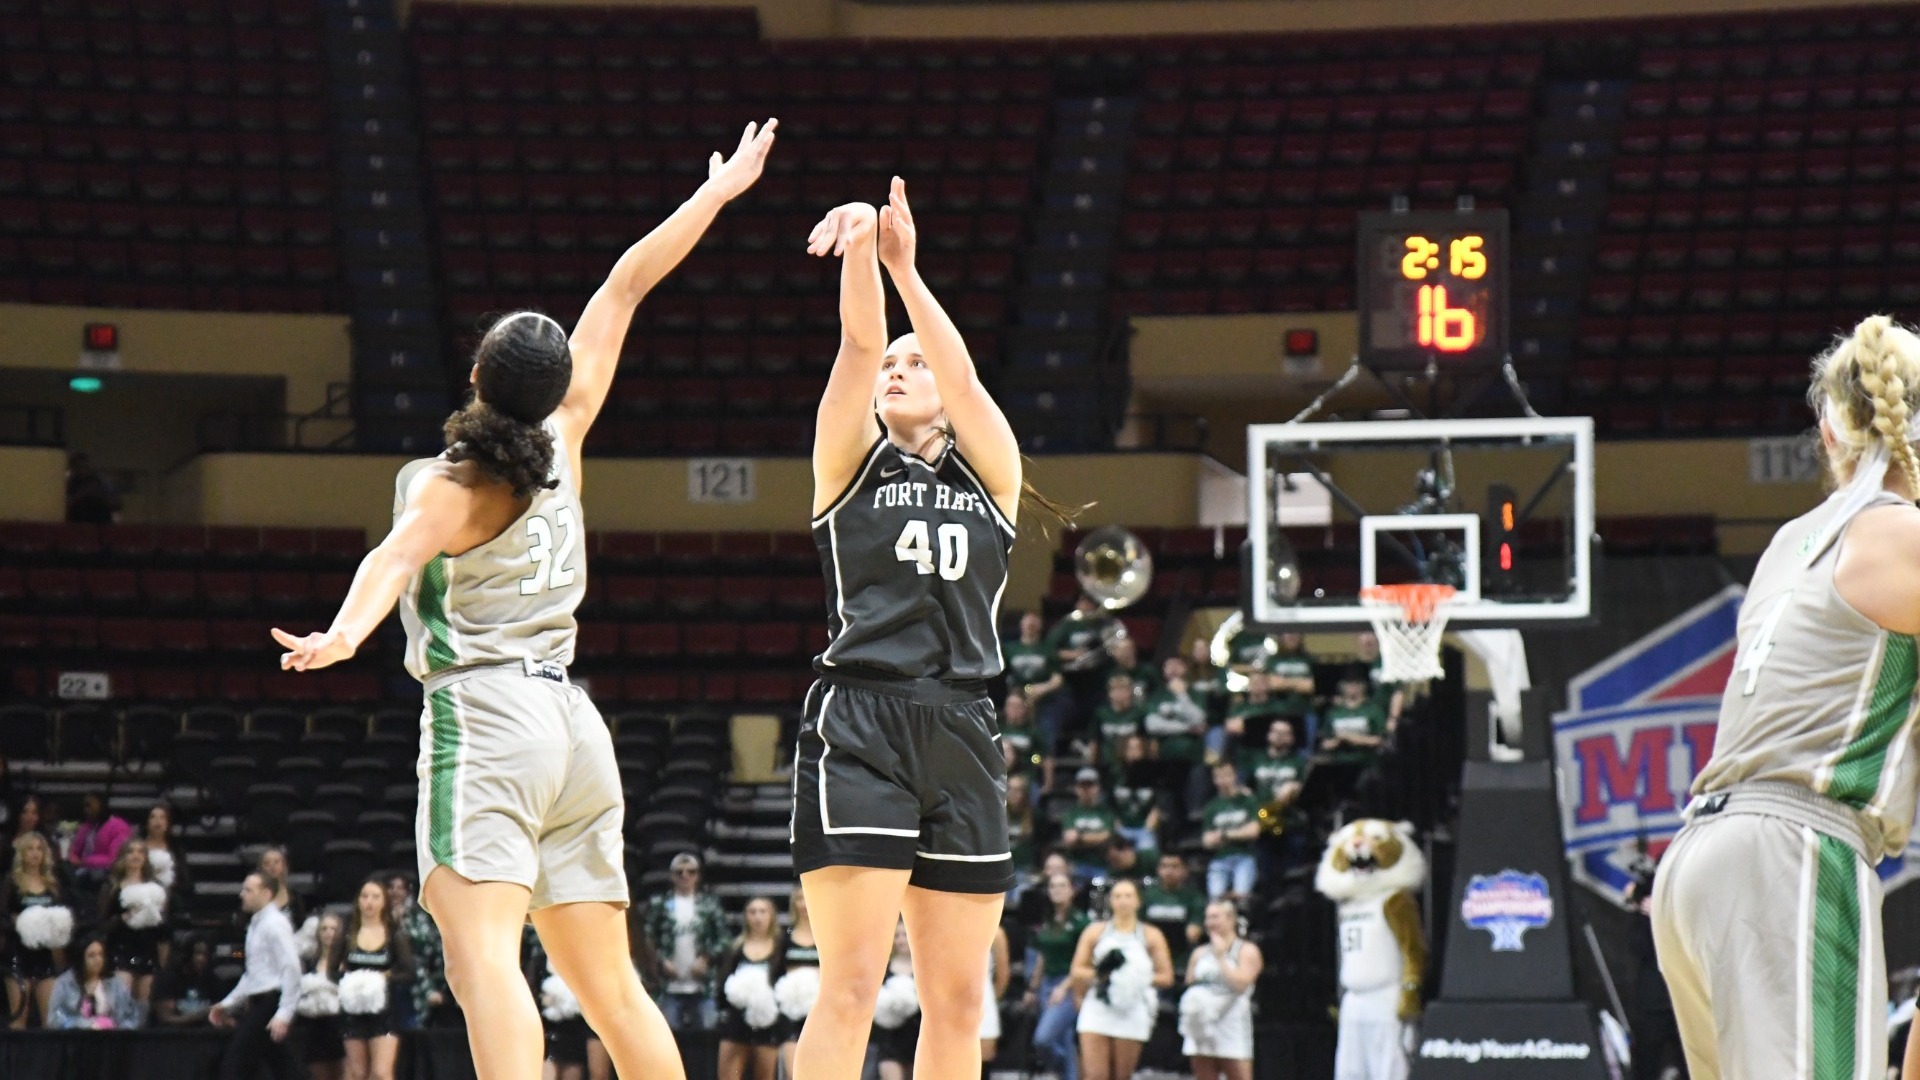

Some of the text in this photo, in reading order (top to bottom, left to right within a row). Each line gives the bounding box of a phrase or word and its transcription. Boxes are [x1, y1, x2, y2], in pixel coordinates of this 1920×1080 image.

[1418, 284, 1476, 351] 16
[697, 463, 748, 497] 121
[873, 482, 927, 508] FORT
[520, 505, 576, 596] 32
[895, 520, 968, 581] 40
[1738, 588, 1794, 696] 4
[1420, 1038, 1591, 1064] #BringYourAGame
